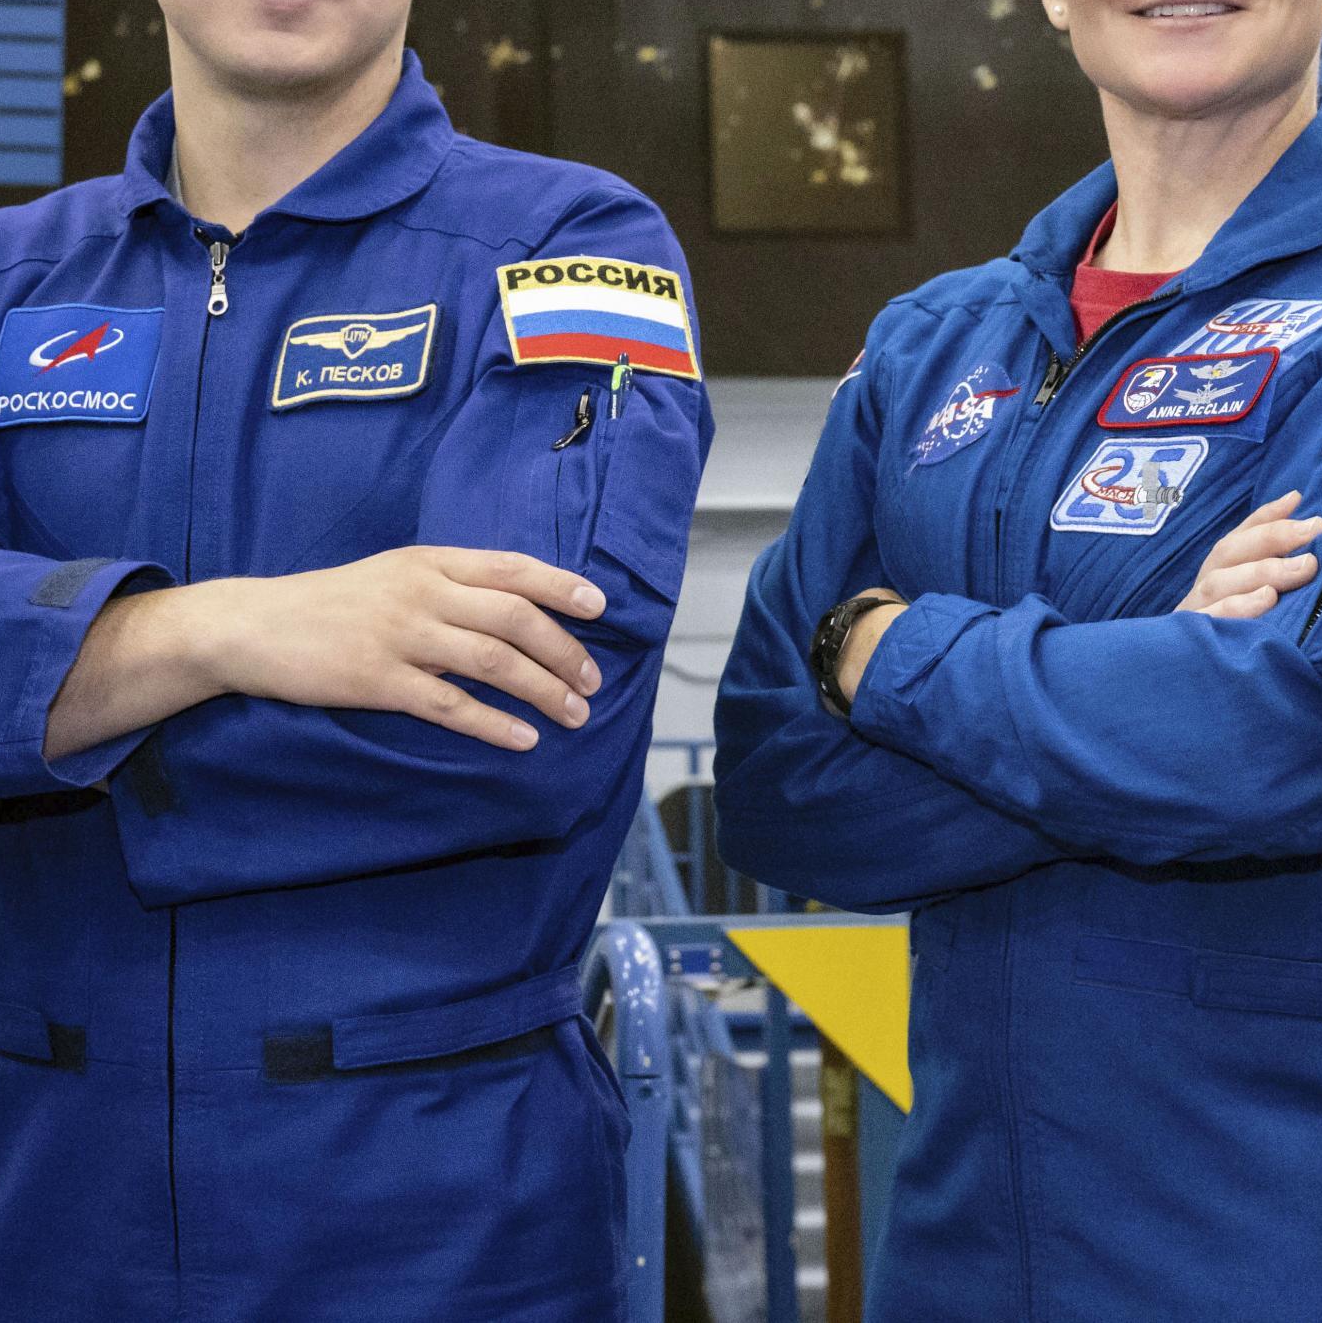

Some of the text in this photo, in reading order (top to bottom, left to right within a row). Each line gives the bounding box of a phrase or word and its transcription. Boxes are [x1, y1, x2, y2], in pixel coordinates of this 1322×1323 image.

[505, 262, 678, 300] РОССИЯ
[319, 363, 403, 383] ПЕСКОВ
[925, 396, 996, 435] NASA
[1146, 399, 1245, 419] ANNE McCLAIN
